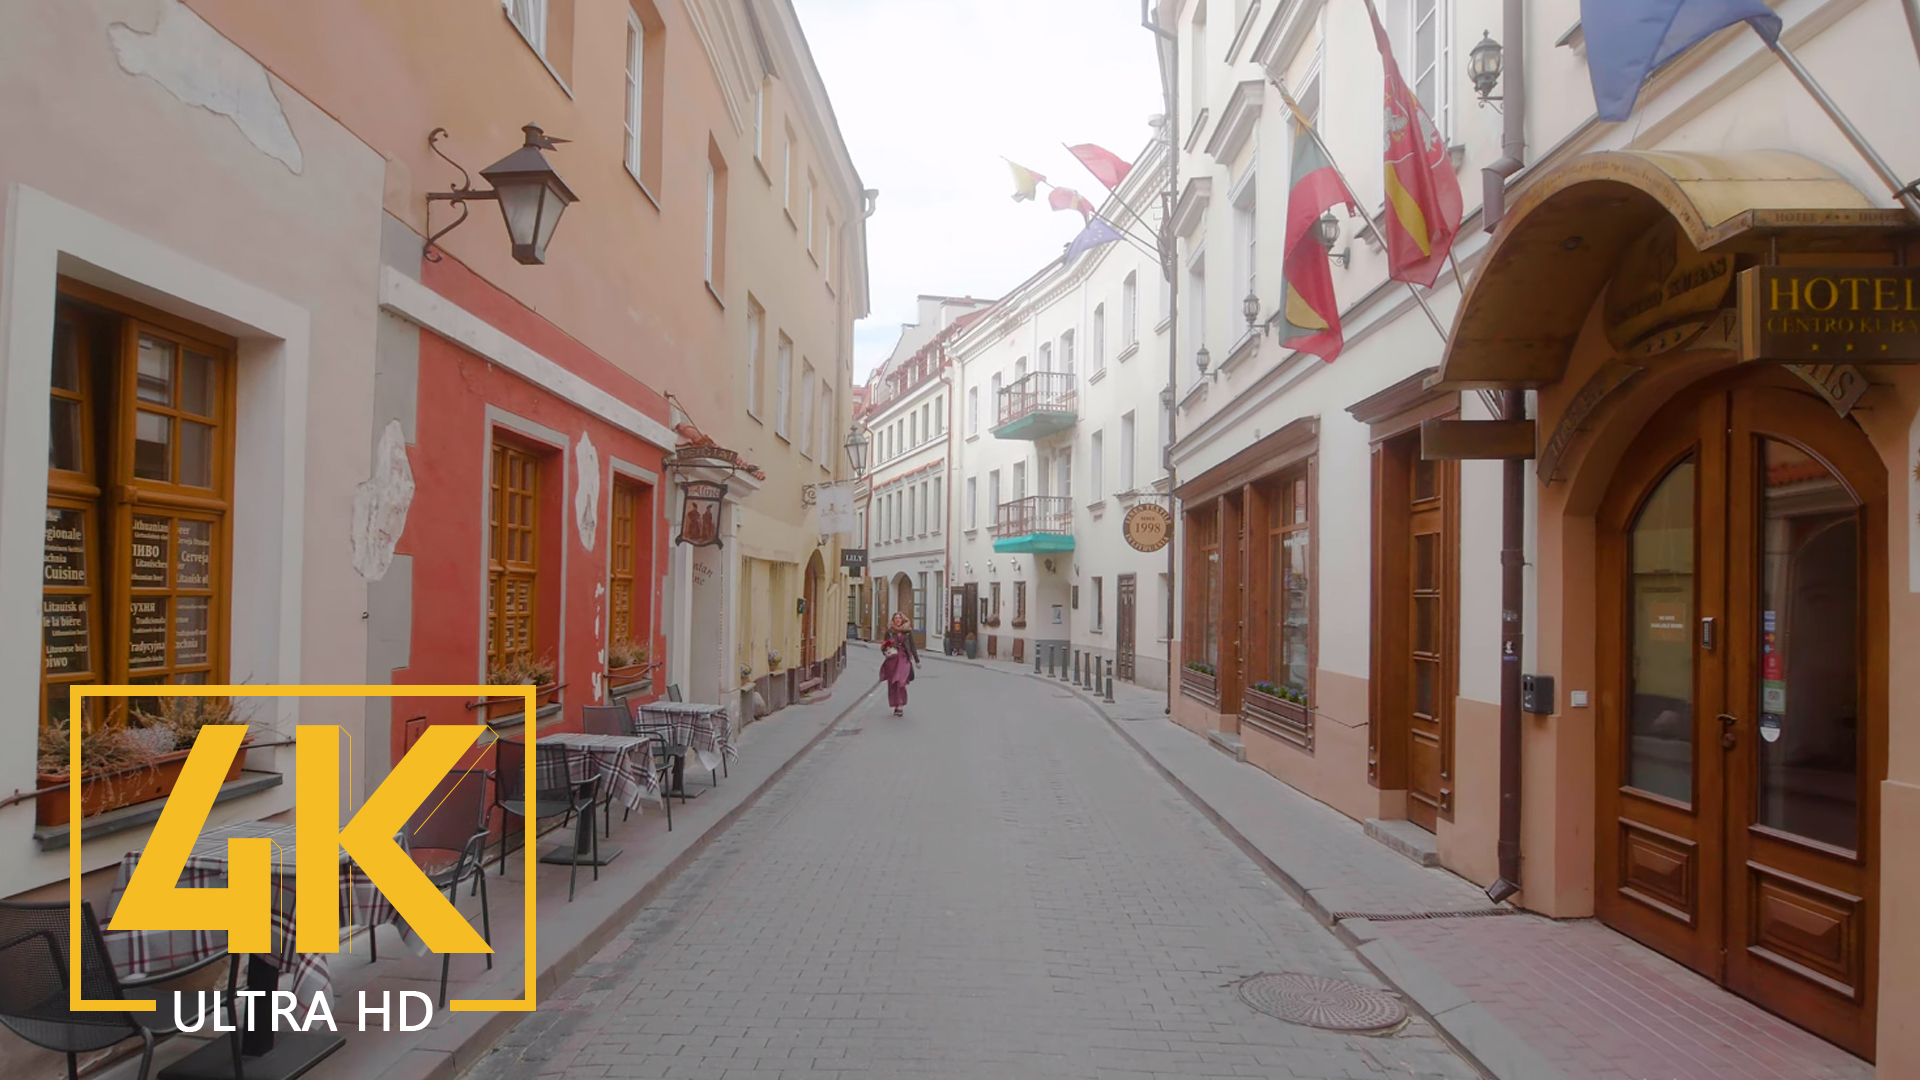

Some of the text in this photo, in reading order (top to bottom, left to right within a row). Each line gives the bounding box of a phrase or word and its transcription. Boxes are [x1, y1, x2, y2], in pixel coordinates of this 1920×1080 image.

[1769, 277, 1920, 311] HOTEL
[1767, 317, 1920, 333] CENTRO KUBA
[132, 519, 168, 532] ithuanian
[1135, 523, 1161, 534] 1998
[45, 526, 82, 542] gionale
[845, 554, 864, 562] LILY
[45, 565, 85, 581] Cuisine
